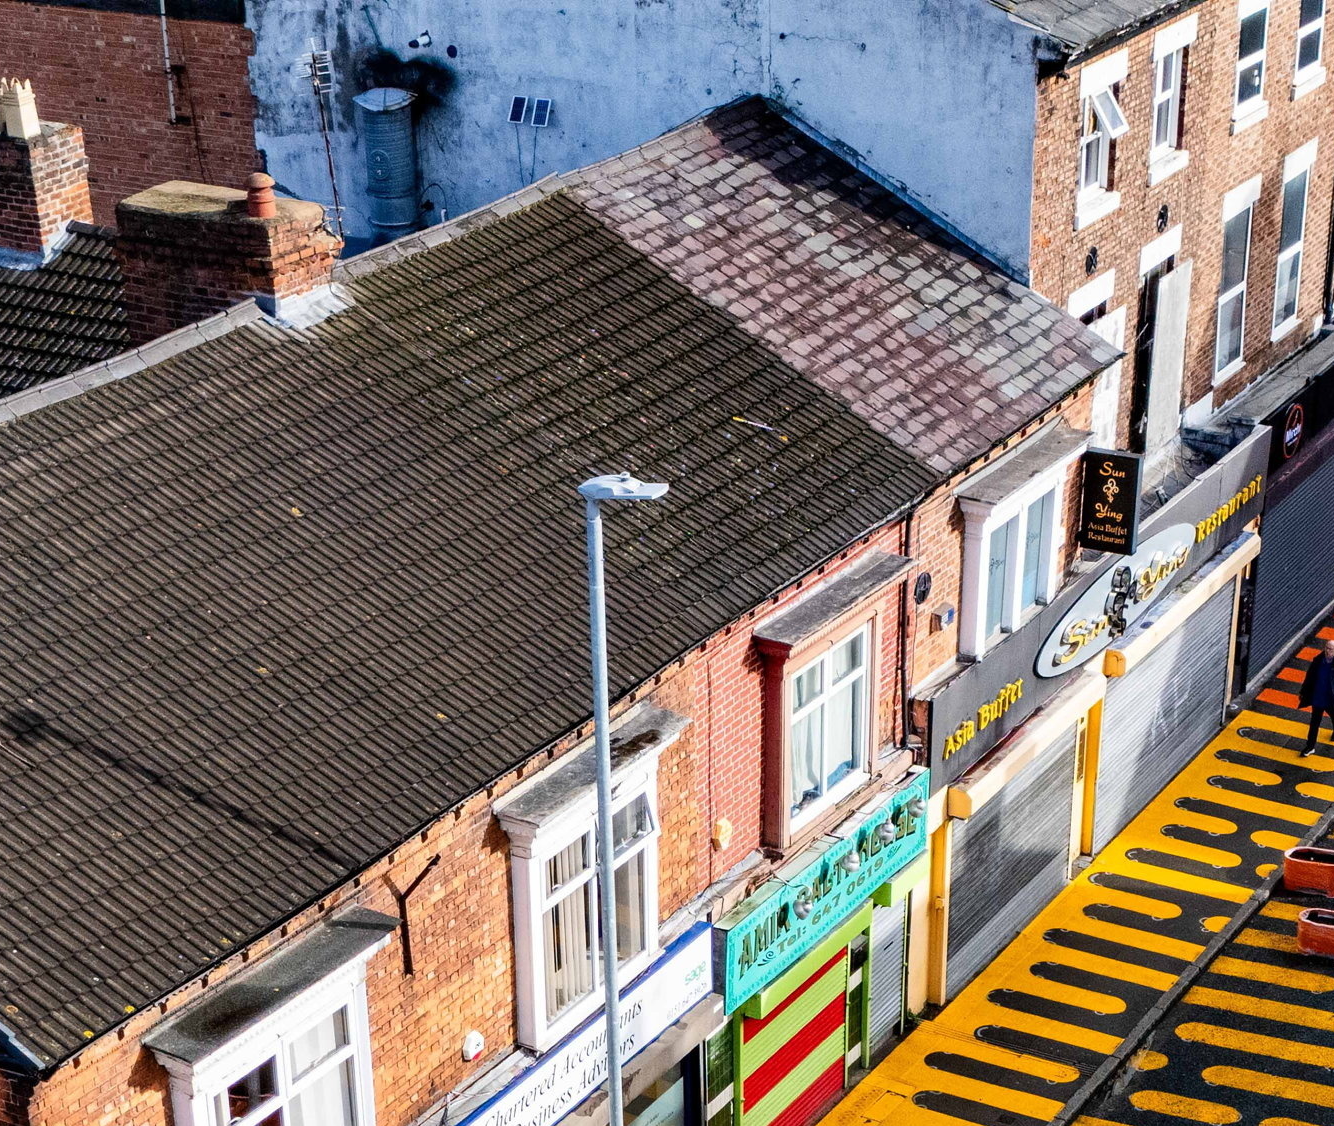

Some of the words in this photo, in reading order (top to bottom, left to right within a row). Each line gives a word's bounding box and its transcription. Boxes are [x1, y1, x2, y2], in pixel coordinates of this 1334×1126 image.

[1099, 461, 1126, 478] Sun
[1087, 521, 1104, 532] Asia
[1105, 523, 1128, 536] Buffet
[1087, 531, 1125, 545] Restaurant
[1095, 502, 1123, 522] Ying
[1195, 474, 1263, 543] Restaurant
[1053, 615, 1110, 667] Sun
[1135, 544, 1189, 602] Ying
[942, 721, 975, 761] Asia
[976, 677, 1024, 731] Buffet
[776, 925, 807, 954] Tel:
[811, 893, 842, 926] 647
[847, 856, 884, 895] 0619
[739, 901, 791, 980] AMIR
